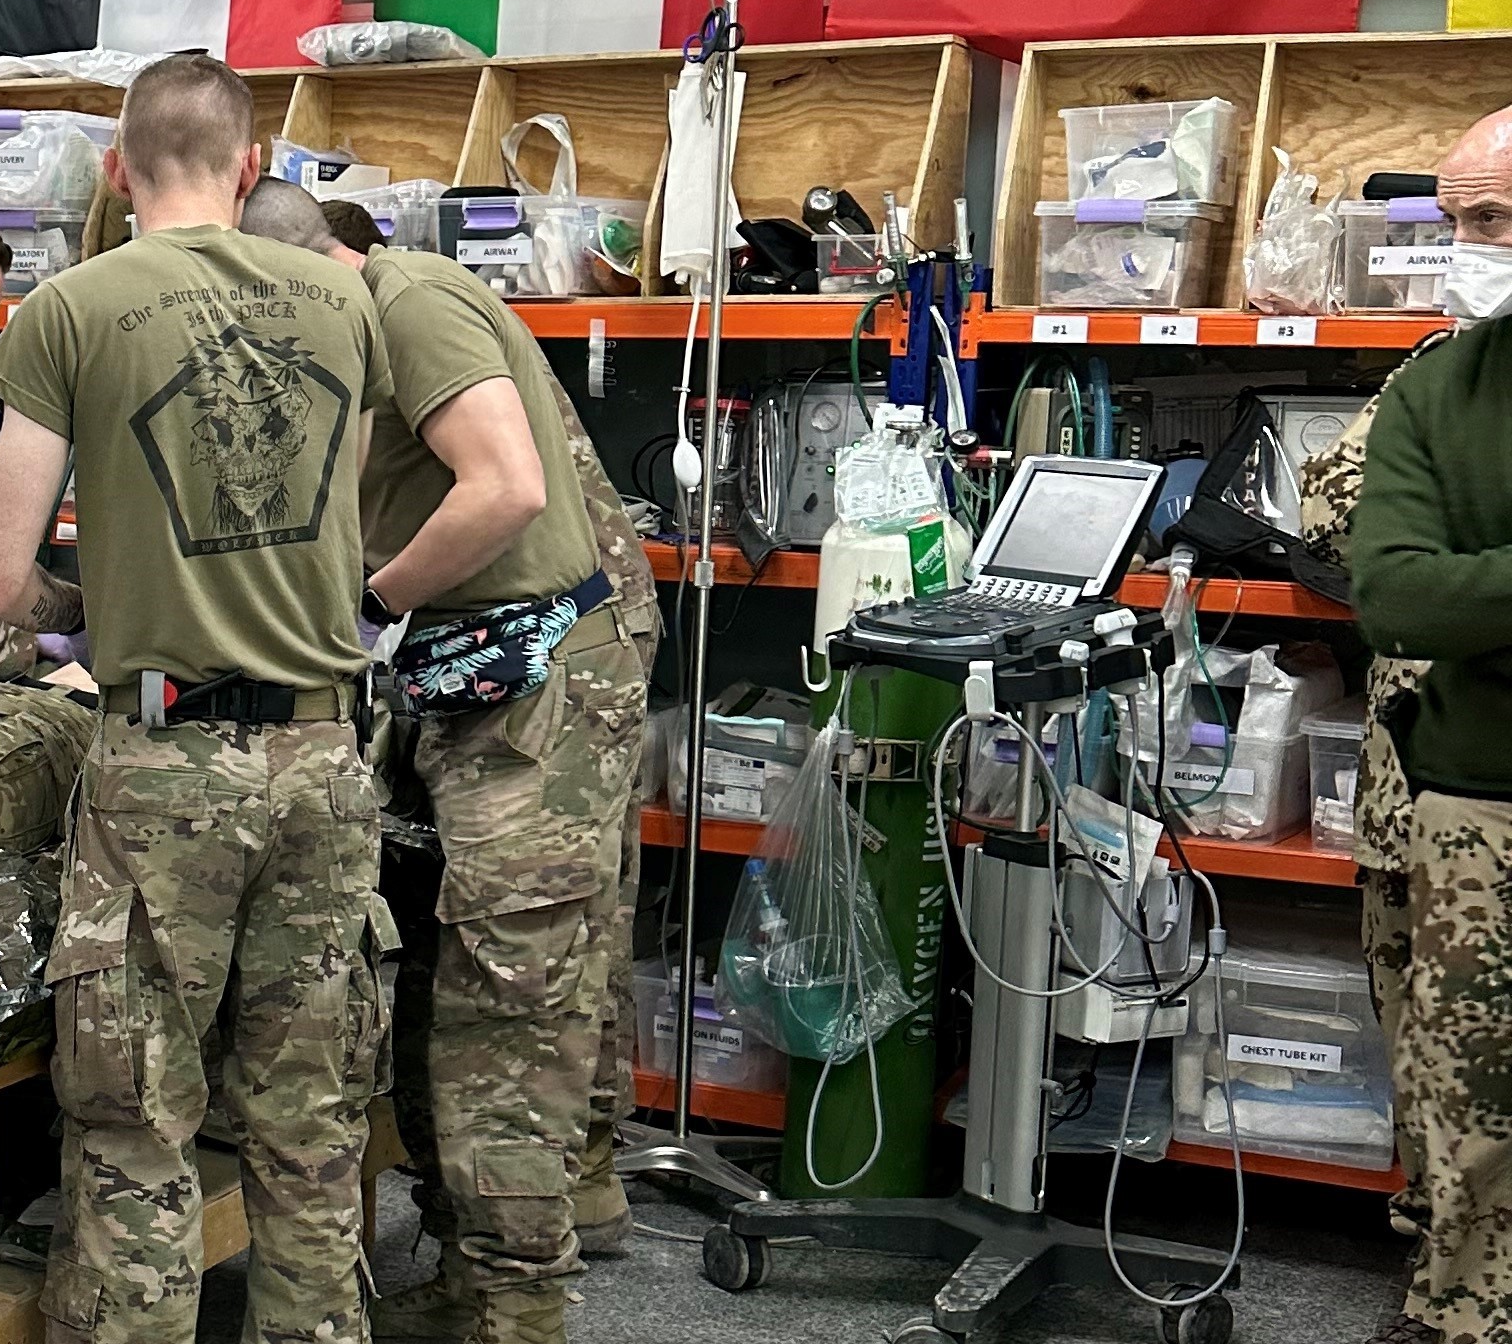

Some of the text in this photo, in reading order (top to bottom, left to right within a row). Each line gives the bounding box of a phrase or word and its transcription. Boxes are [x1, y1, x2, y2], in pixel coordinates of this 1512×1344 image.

[483, 248, 518, 256] AIRWAY
[1371, 256, 1385, 265] #7
[117, 305, 153, 332] The
[230, 283, 245, 301] of
[253, 281, 278, 300] the
[287, 279, 348, 311] WOLF
[237, 302, 297, 323] PACK
[1052, 325, 1067, 335] #1
[1161, 325, 1177, 336] #2
[1278, 326, 1294, 337] #3
[1175, 771, 1220, 784] BELMON
[709, 1030, 740, 1046] FLUIDS
[1241, 1044, 1327, 1062] CHEST TUBE KIT
